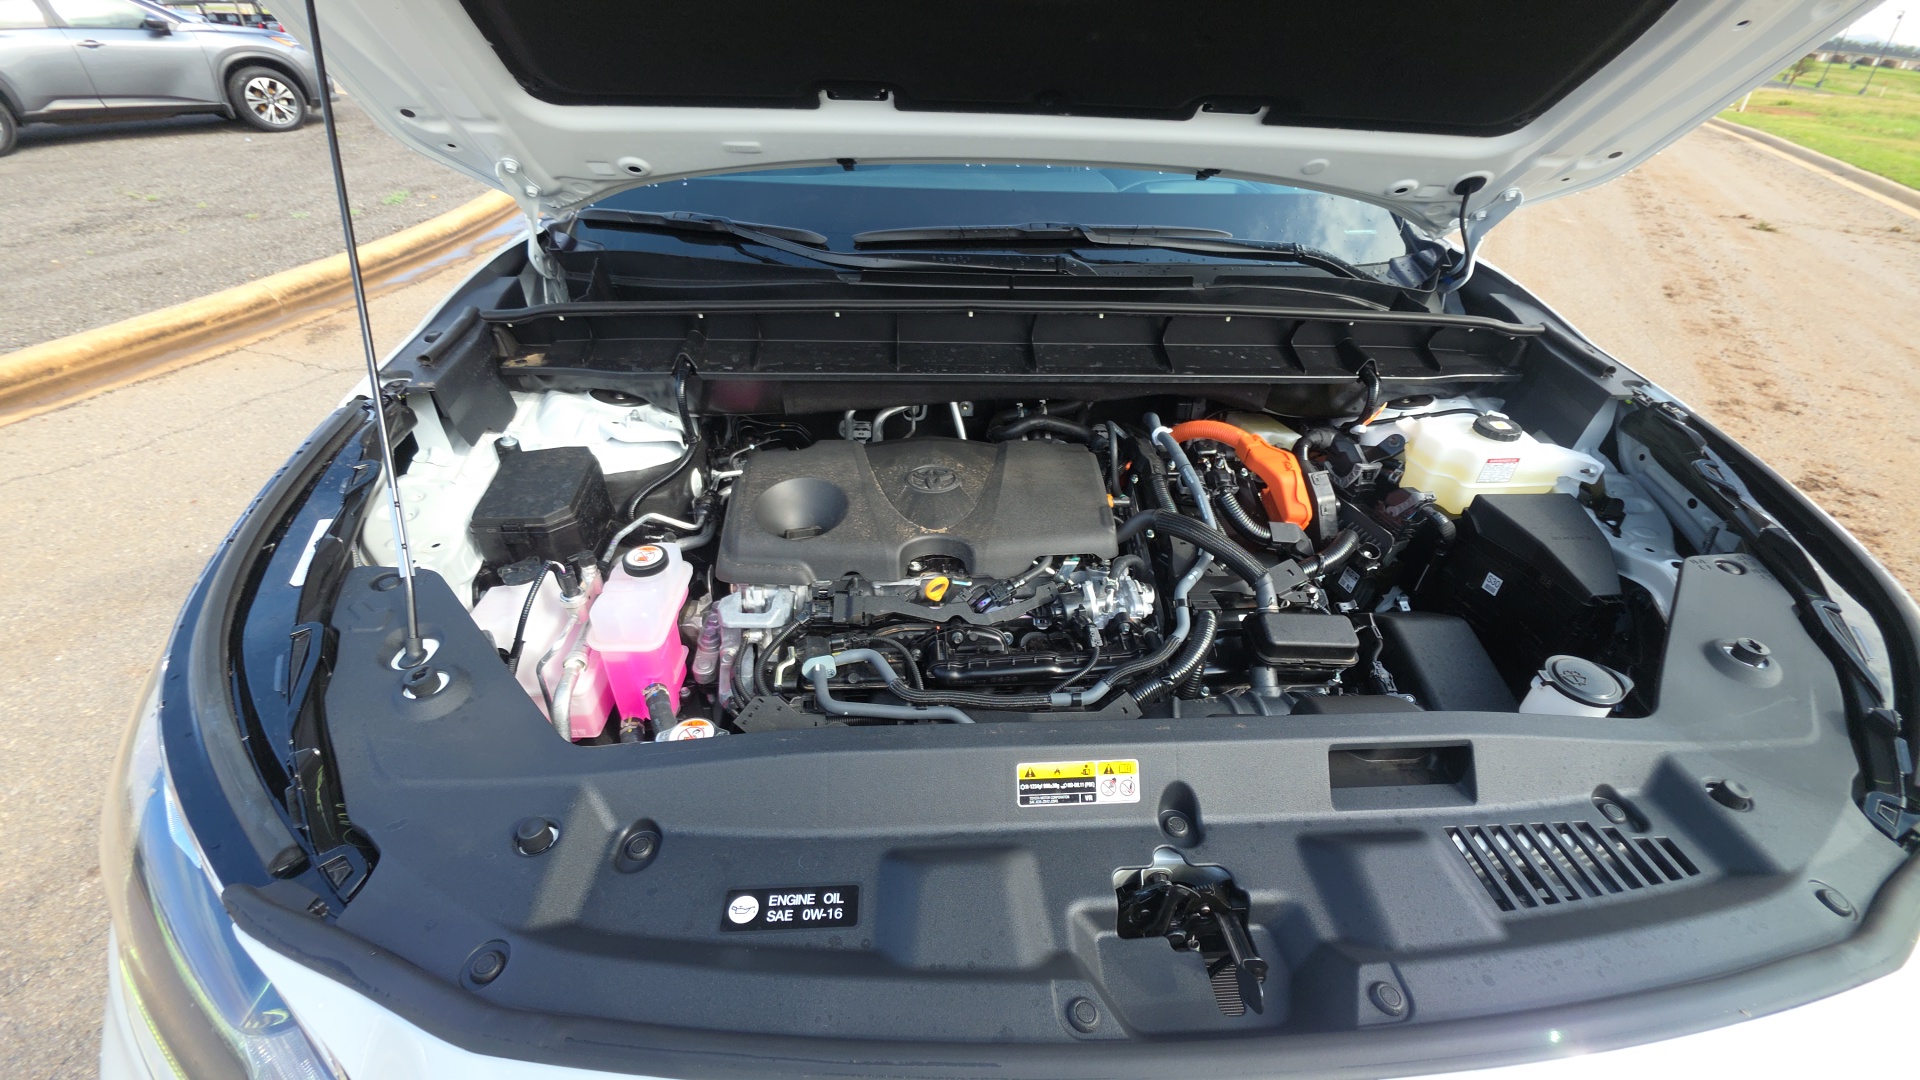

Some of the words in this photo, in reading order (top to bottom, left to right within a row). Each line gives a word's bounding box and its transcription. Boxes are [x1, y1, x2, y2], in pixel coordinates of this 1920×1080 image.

[1486, 575, 1501, 588] S30
[768, 893, 816, 906] ENGINE
[823, 892, 844, 904] OIL
[766, 909, 794, 922] SAE
[802, 907, 843, 921] 0W-16
